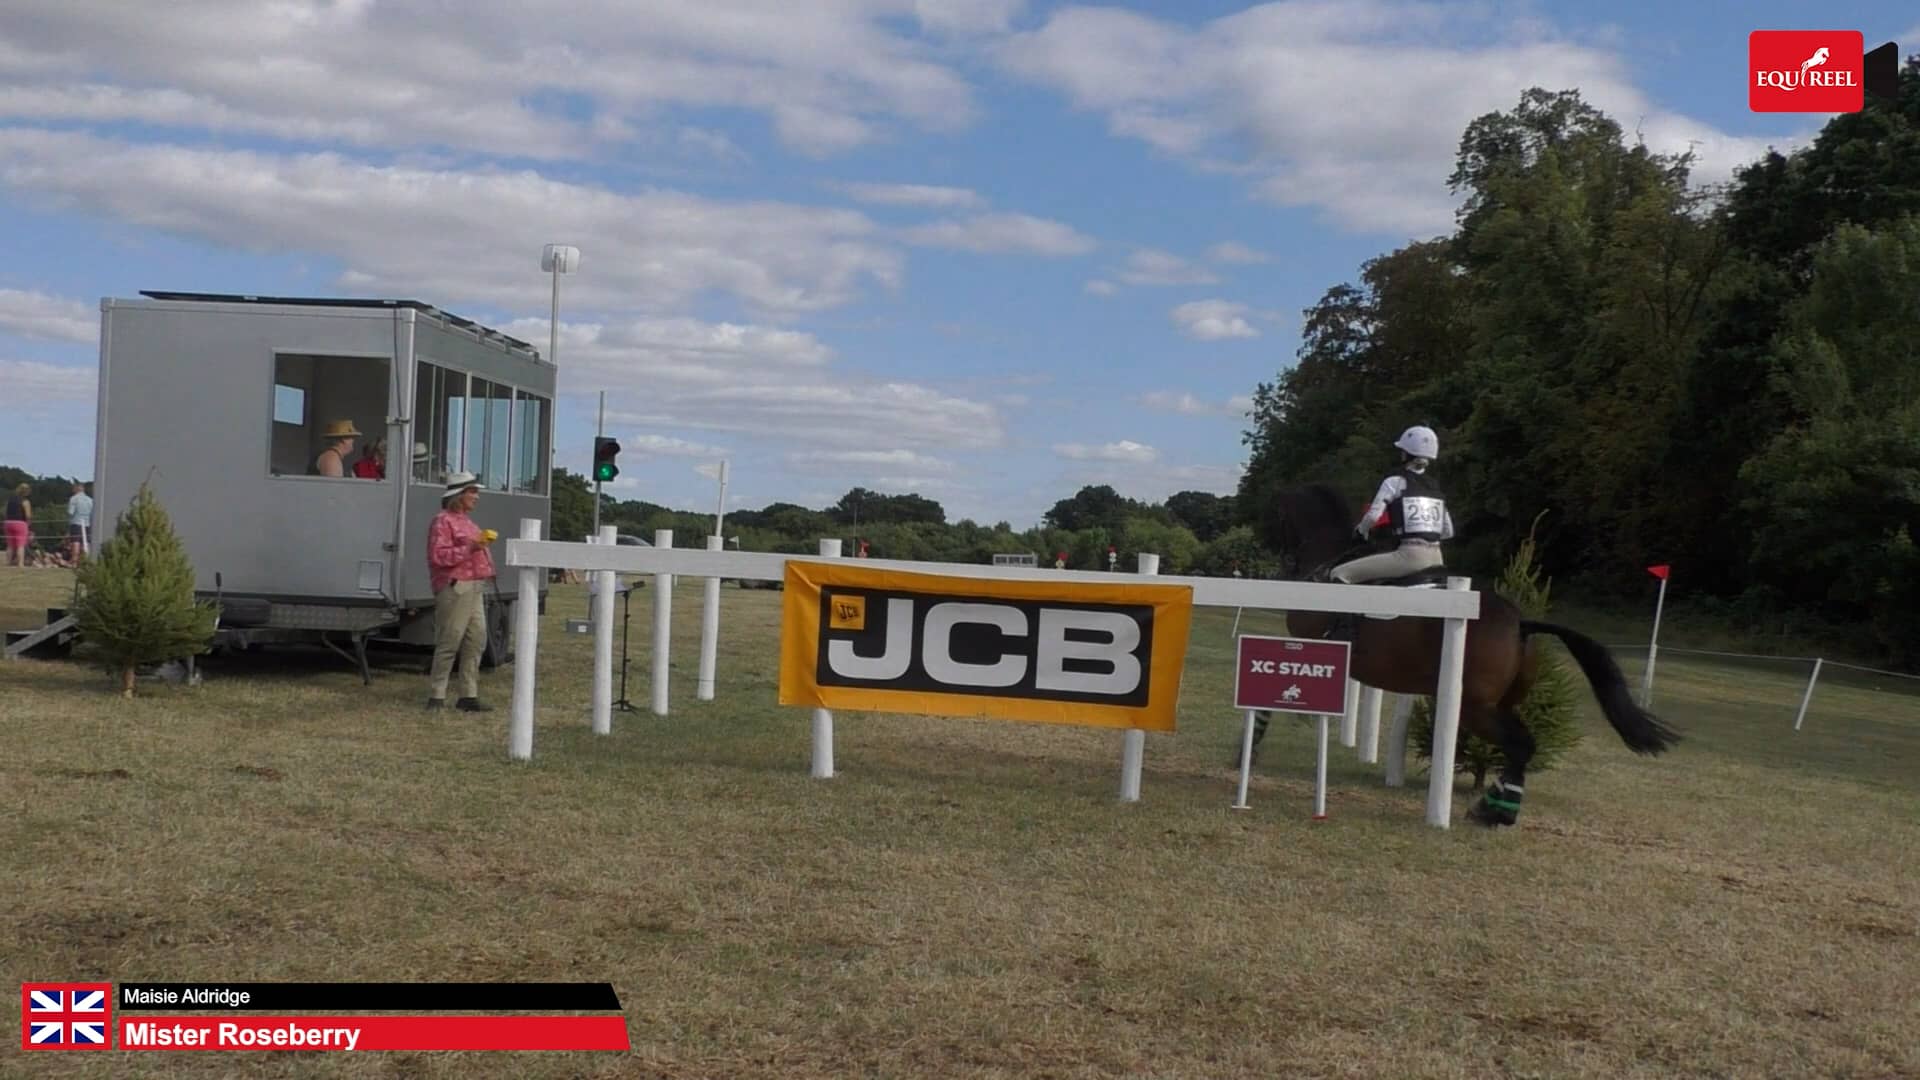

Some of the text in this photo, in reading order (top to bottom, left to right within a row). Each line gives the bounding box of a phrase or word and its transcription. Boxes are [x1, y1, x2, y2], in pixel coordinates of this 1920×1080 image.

[828, 598, 1142, 695] JCB
[1250, 660, 1336, 678] XC START
